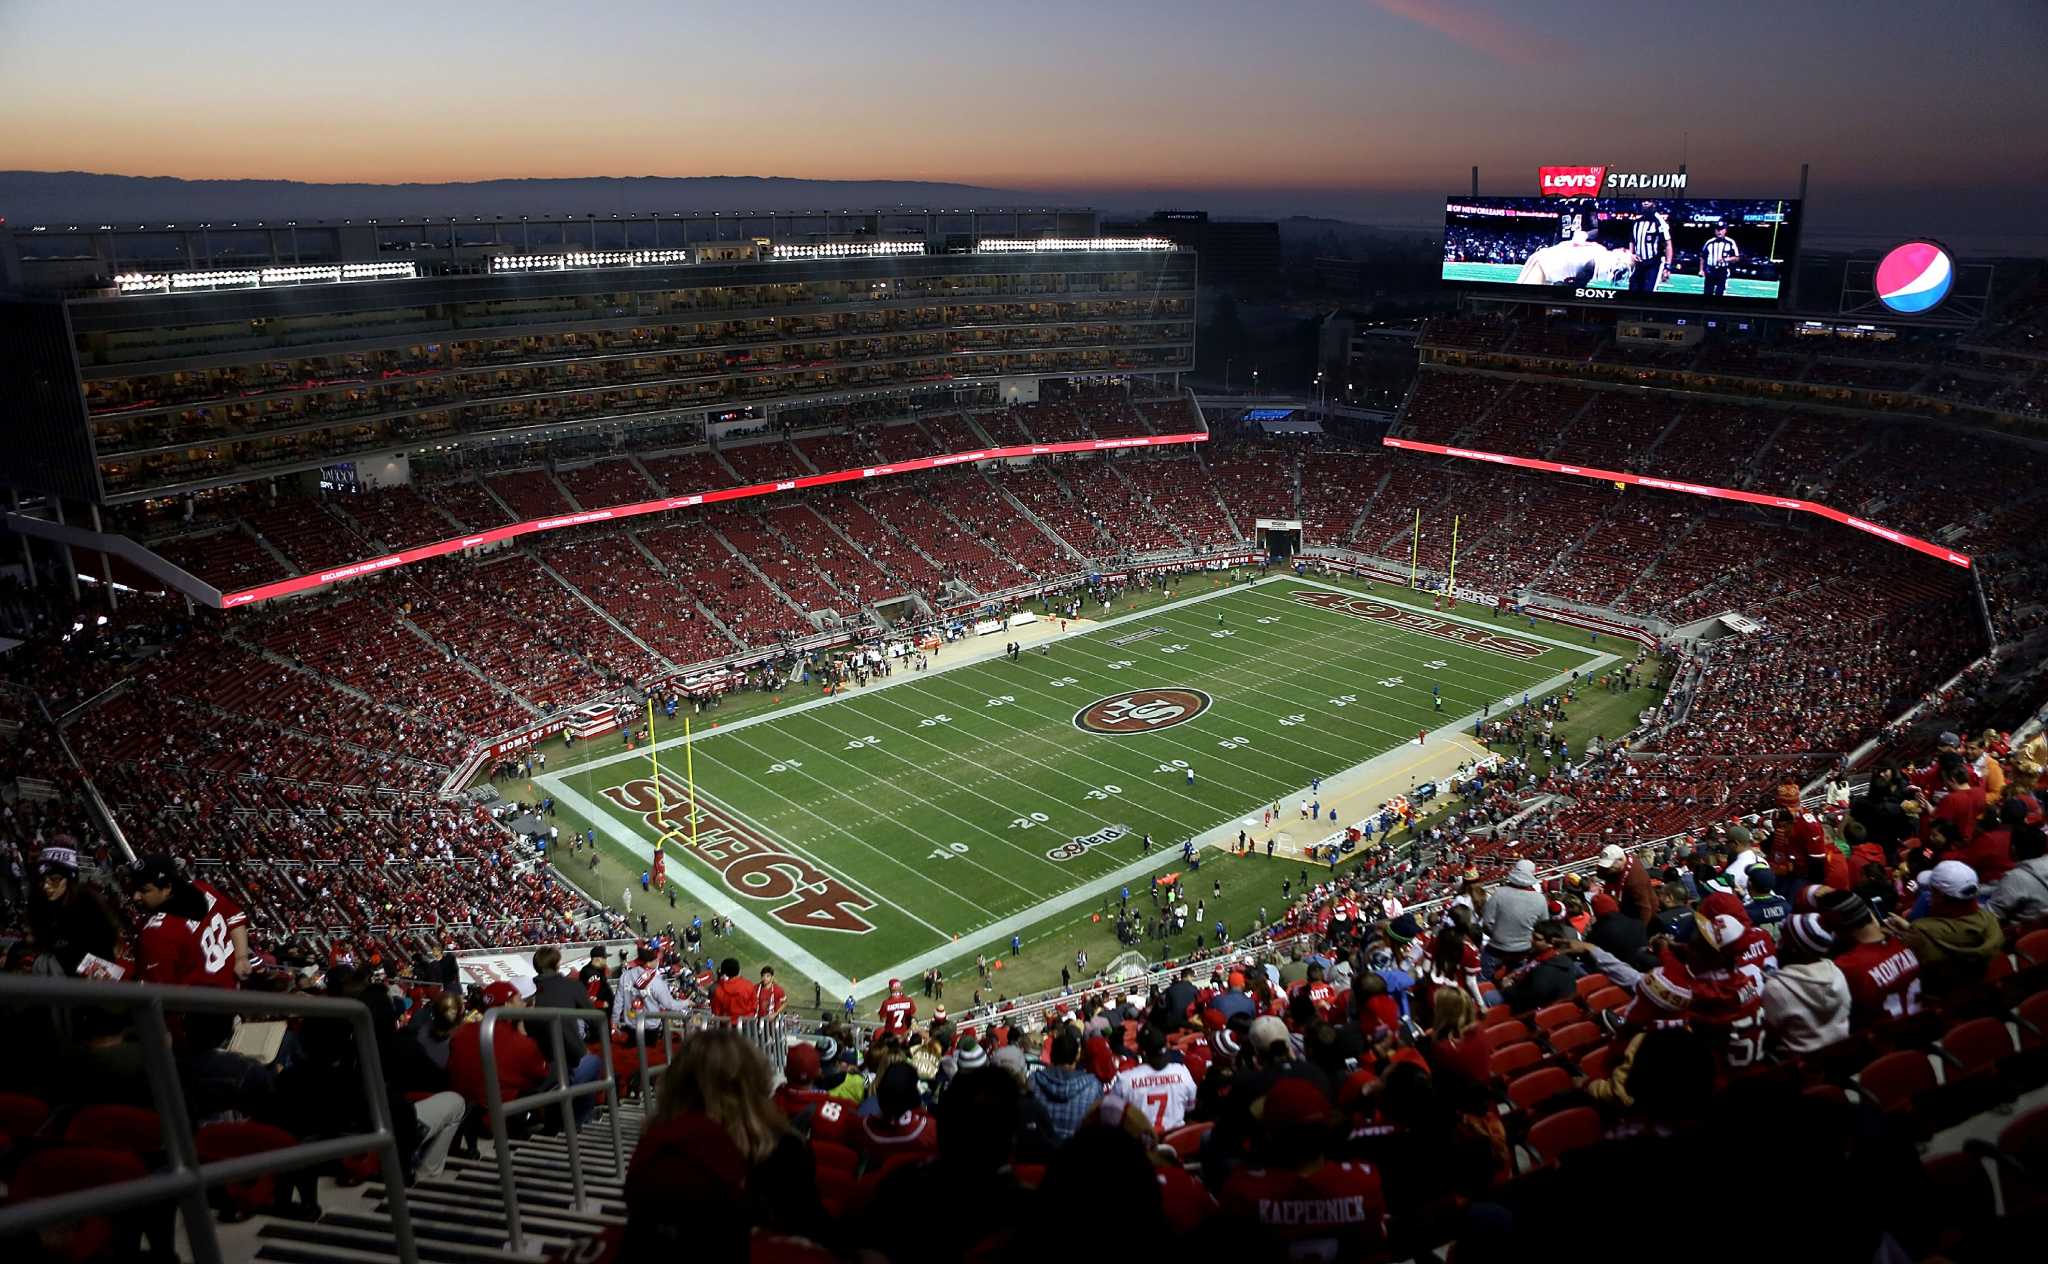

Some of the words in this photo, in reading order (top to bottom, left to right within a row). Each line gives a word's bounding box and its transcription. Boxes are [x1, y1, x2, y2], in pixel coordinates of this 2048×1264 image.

[1607, 174, 1687, 189] STADIUM
[1575, 288, 1616, 299] SONY
[1050, 676, 1079, 688] 50
[987, 695, 1016, 707] 40
[921, 713, 952, 727] 30
[1278, 713, 1305, 727] 40
[500, 735, 529, 753] HOME
[531, 728, 544, 740] OF
[547, 720, 567, 734] THE
[848, 735, 883, 749] 20
[1218, 736, 1250, 750] 50
[771, 758, 803, 772] 10
[1159, 759, 1190, 773] 40
[1087, 784, 1123, 800] 30
[1013, 812, 1049, 829] 20
[933, 842, 969, 860] 10
[200, 913, 234, 973] 82
[894, 1010, 904, 1029] 7
[1131, 1073, 1184, 1089] KAEPERNICK
[1147, 1094, 1169, 1136] 7
[1258, 1194, 1366, 1225] KAEPERNICK
